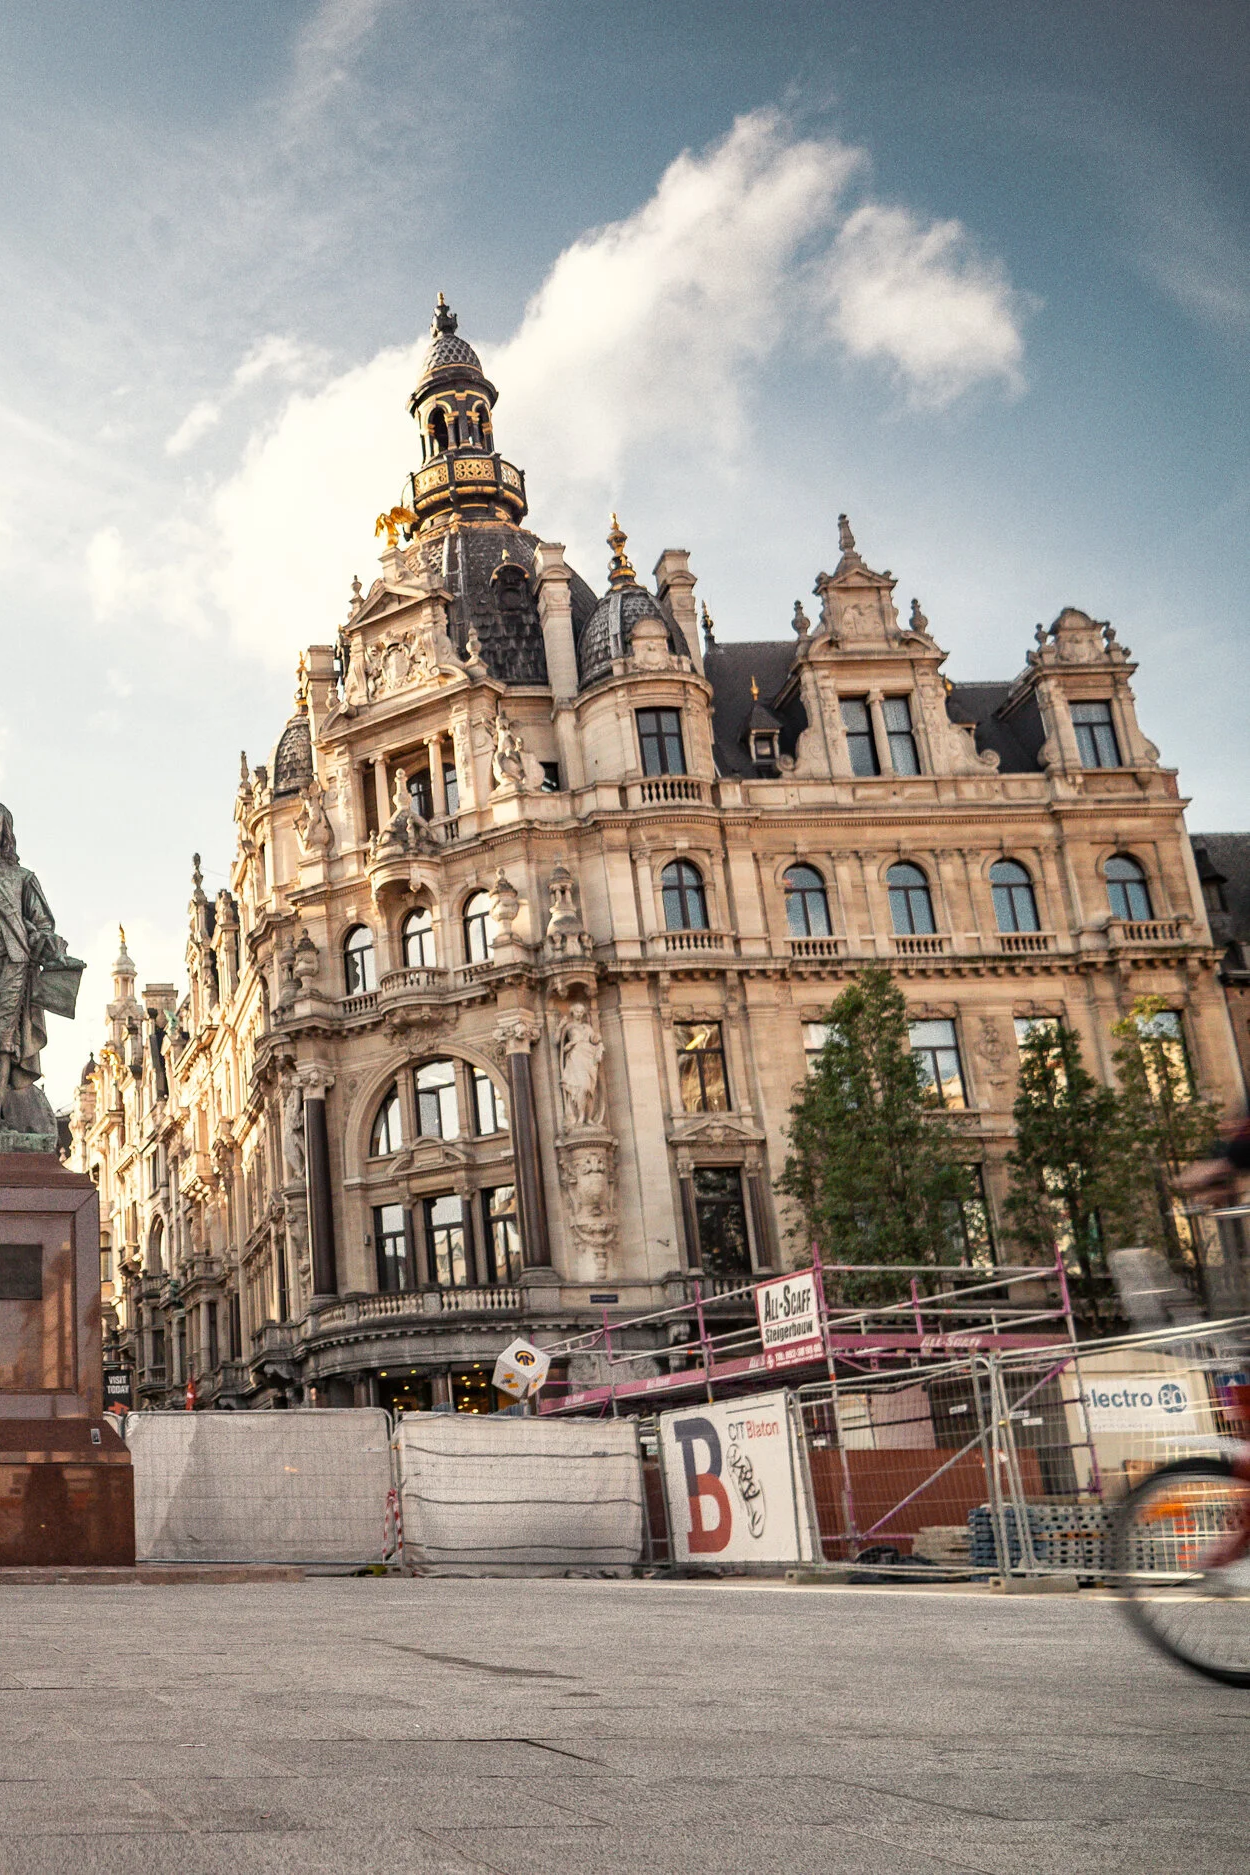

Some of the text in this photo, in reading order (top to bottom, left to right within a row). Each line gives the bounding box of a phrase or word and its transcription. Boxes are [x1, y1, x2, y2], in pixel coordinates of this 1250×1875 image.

[765, 1319, 813, 1344] Steigerbouw
[106, 1385, 130, 1394] TODAY
[108, 1375, 127, 1384] VISIT
[745, 1420, 780, 1440] Blaton
[673, 1417, 732, 1554] B
